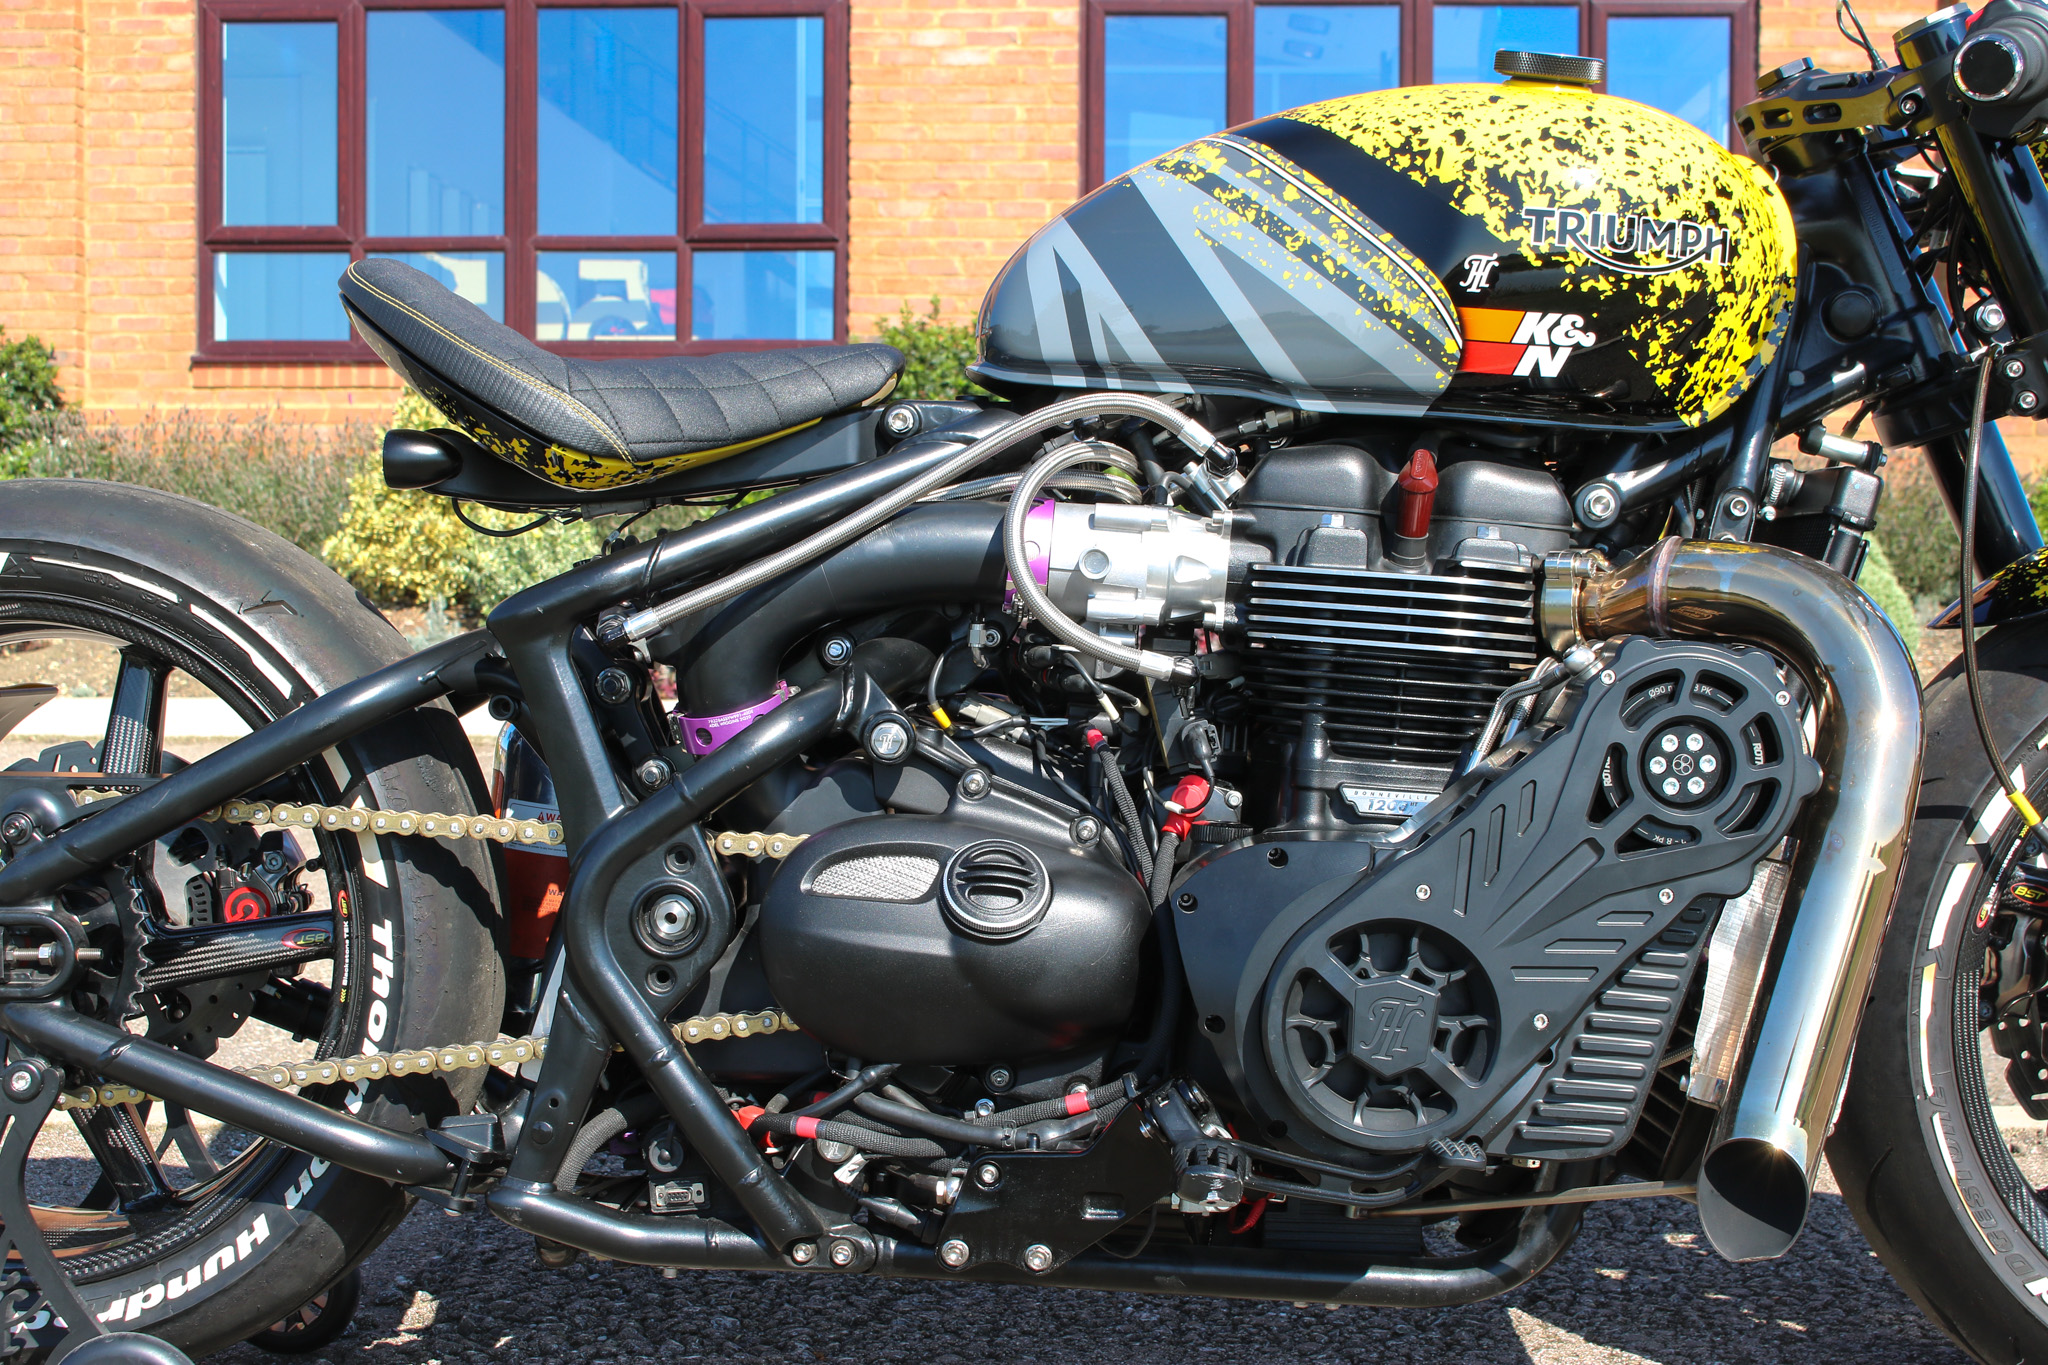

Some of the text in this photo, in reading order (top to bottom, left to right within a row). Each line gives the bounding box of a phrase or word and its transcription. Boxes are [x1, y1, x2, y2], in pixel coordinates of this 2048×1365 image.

[1521, 206, 1731, 275] TRIUMPH
[1354, 790, 1428, 800] BONNEVILLE
[2014, 885, 2046, 900] BST
